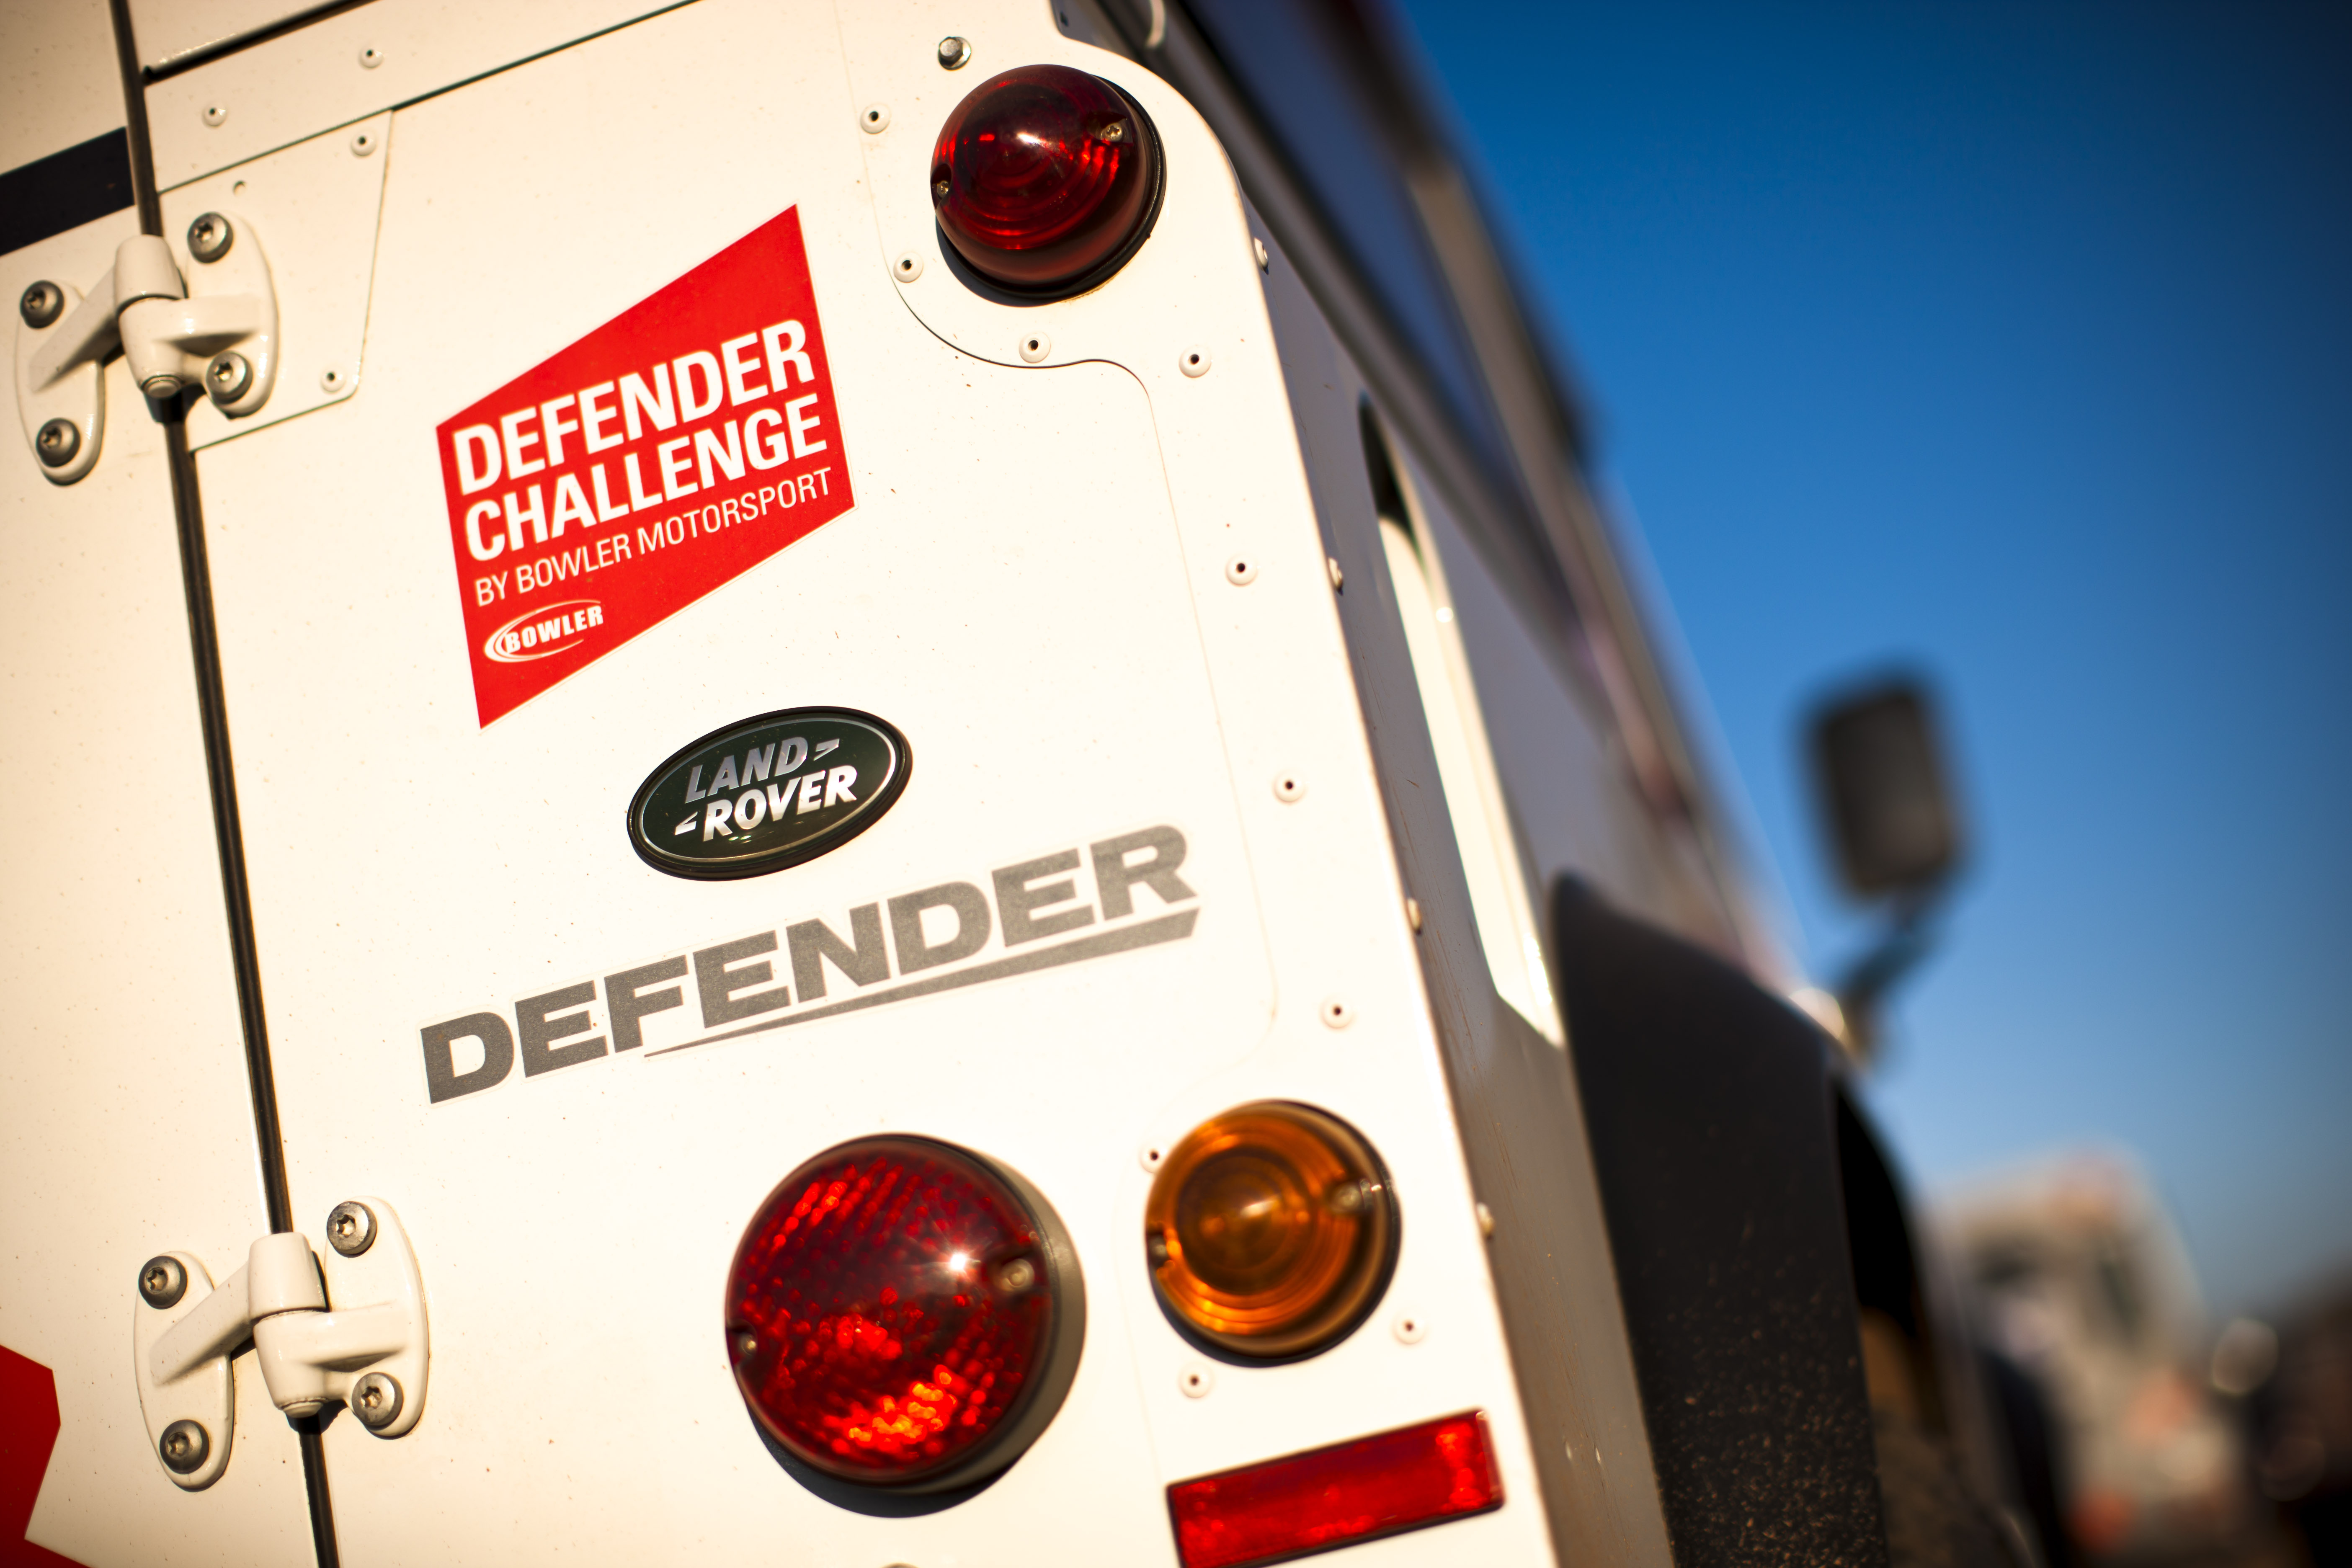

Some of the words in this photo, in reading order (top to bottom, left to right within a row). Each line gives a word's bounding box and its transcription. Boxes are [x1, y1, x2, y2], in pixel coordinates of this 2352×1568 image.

[453, 319, 815, 496] DEFENDER
[464, 392, 828, 562] CHALLENGE
[475, 570, 508, 607] BY
[515, 533, 632, 594] BOWLER
[637, 466, 831, 555] MOTORSPORT
[504, 605, 604, 654] BOWLER
[685, 736, 808, 804] LAND
[703, 765, 858, 842] ROVER
[420, 825, 1198, 1104] DEFENDER
